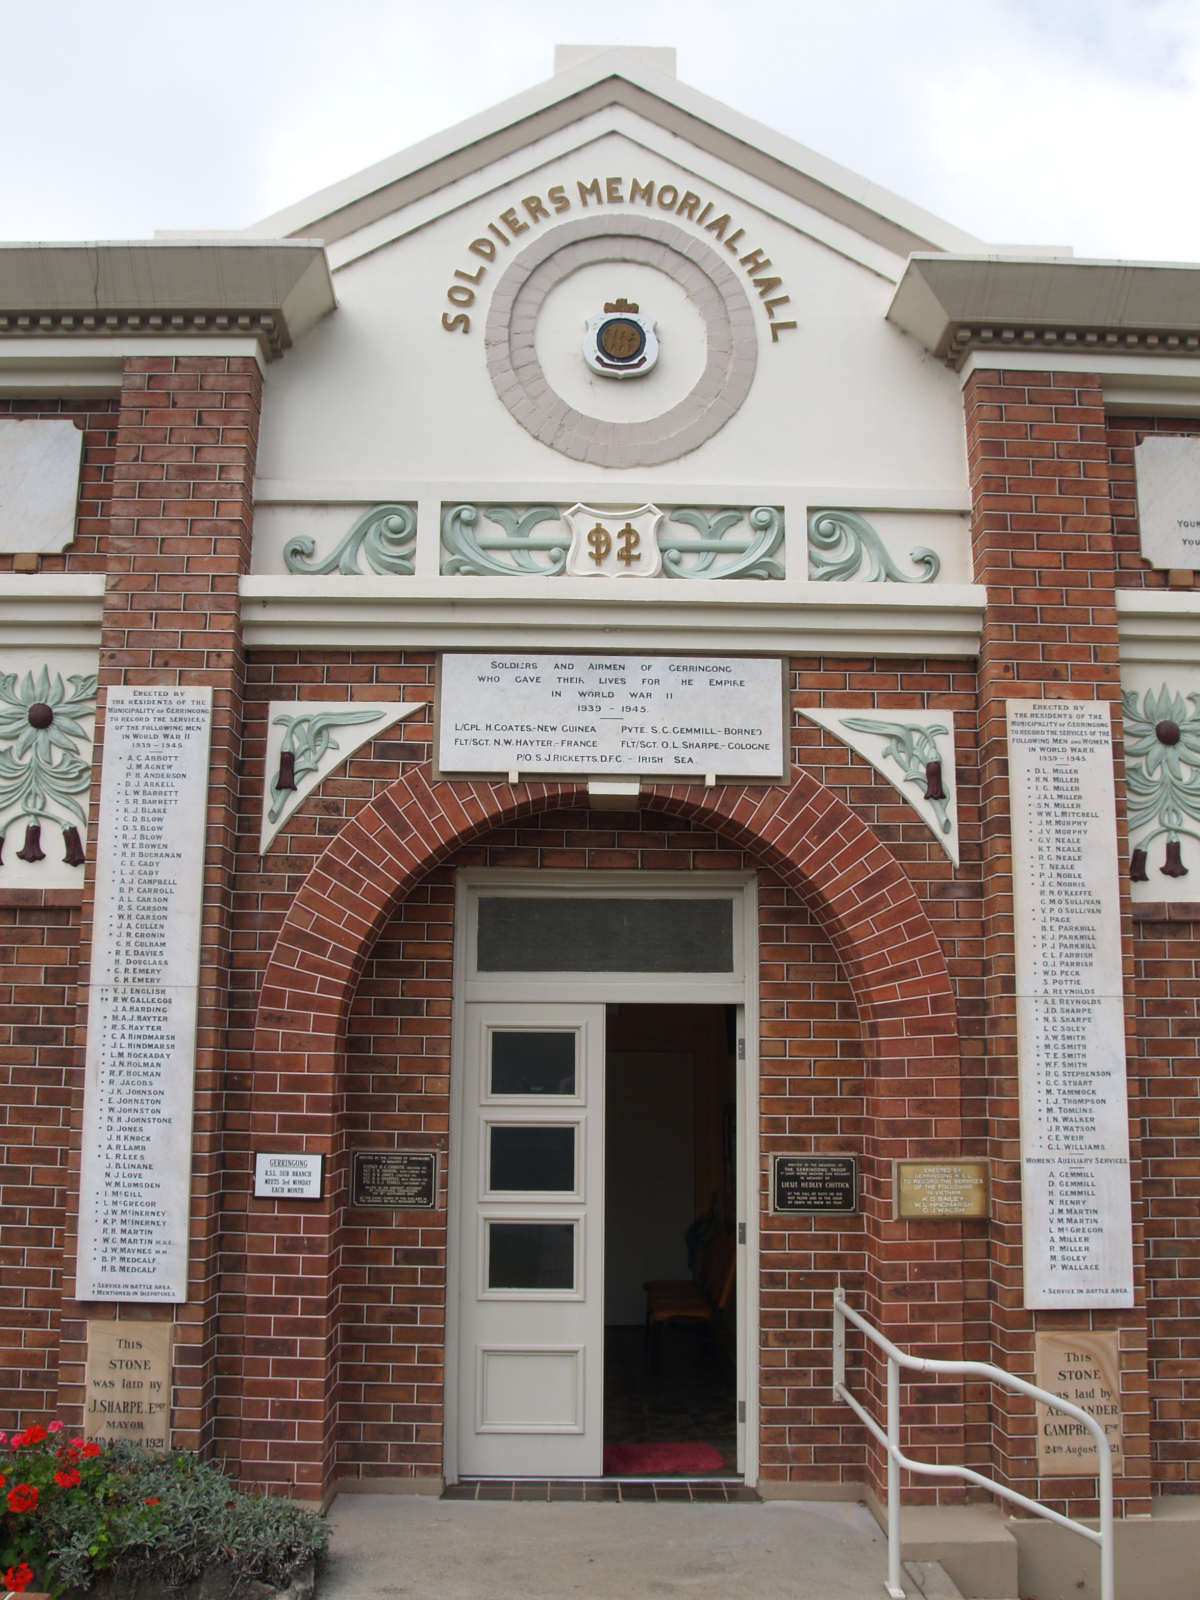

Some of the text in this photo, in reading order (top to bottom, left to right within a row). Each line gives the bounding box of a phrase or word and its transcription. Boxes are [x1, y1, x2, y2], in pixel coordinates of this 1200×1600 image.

[442, 177, 797, 342] SOLDIERS MEMORIAL HALL
[491, 661, 538, 669] SOLDIERS
[728, 742, 770, 750] COLOGNE
[270, 1159, 307, 1167] GERRINGONG
[109, 1359, 151, 1370] STONE
[1058, 1370, 1101, 1380] STONE
[1075, 1389, 1095, 1399] laid
[1100, 1388, 1112, 1401] by
[107, 1421, 144, 1429] MAYOR
[146, 1438, 164, 1448] 1921
[1066, 1446, 1097, 1457] August
